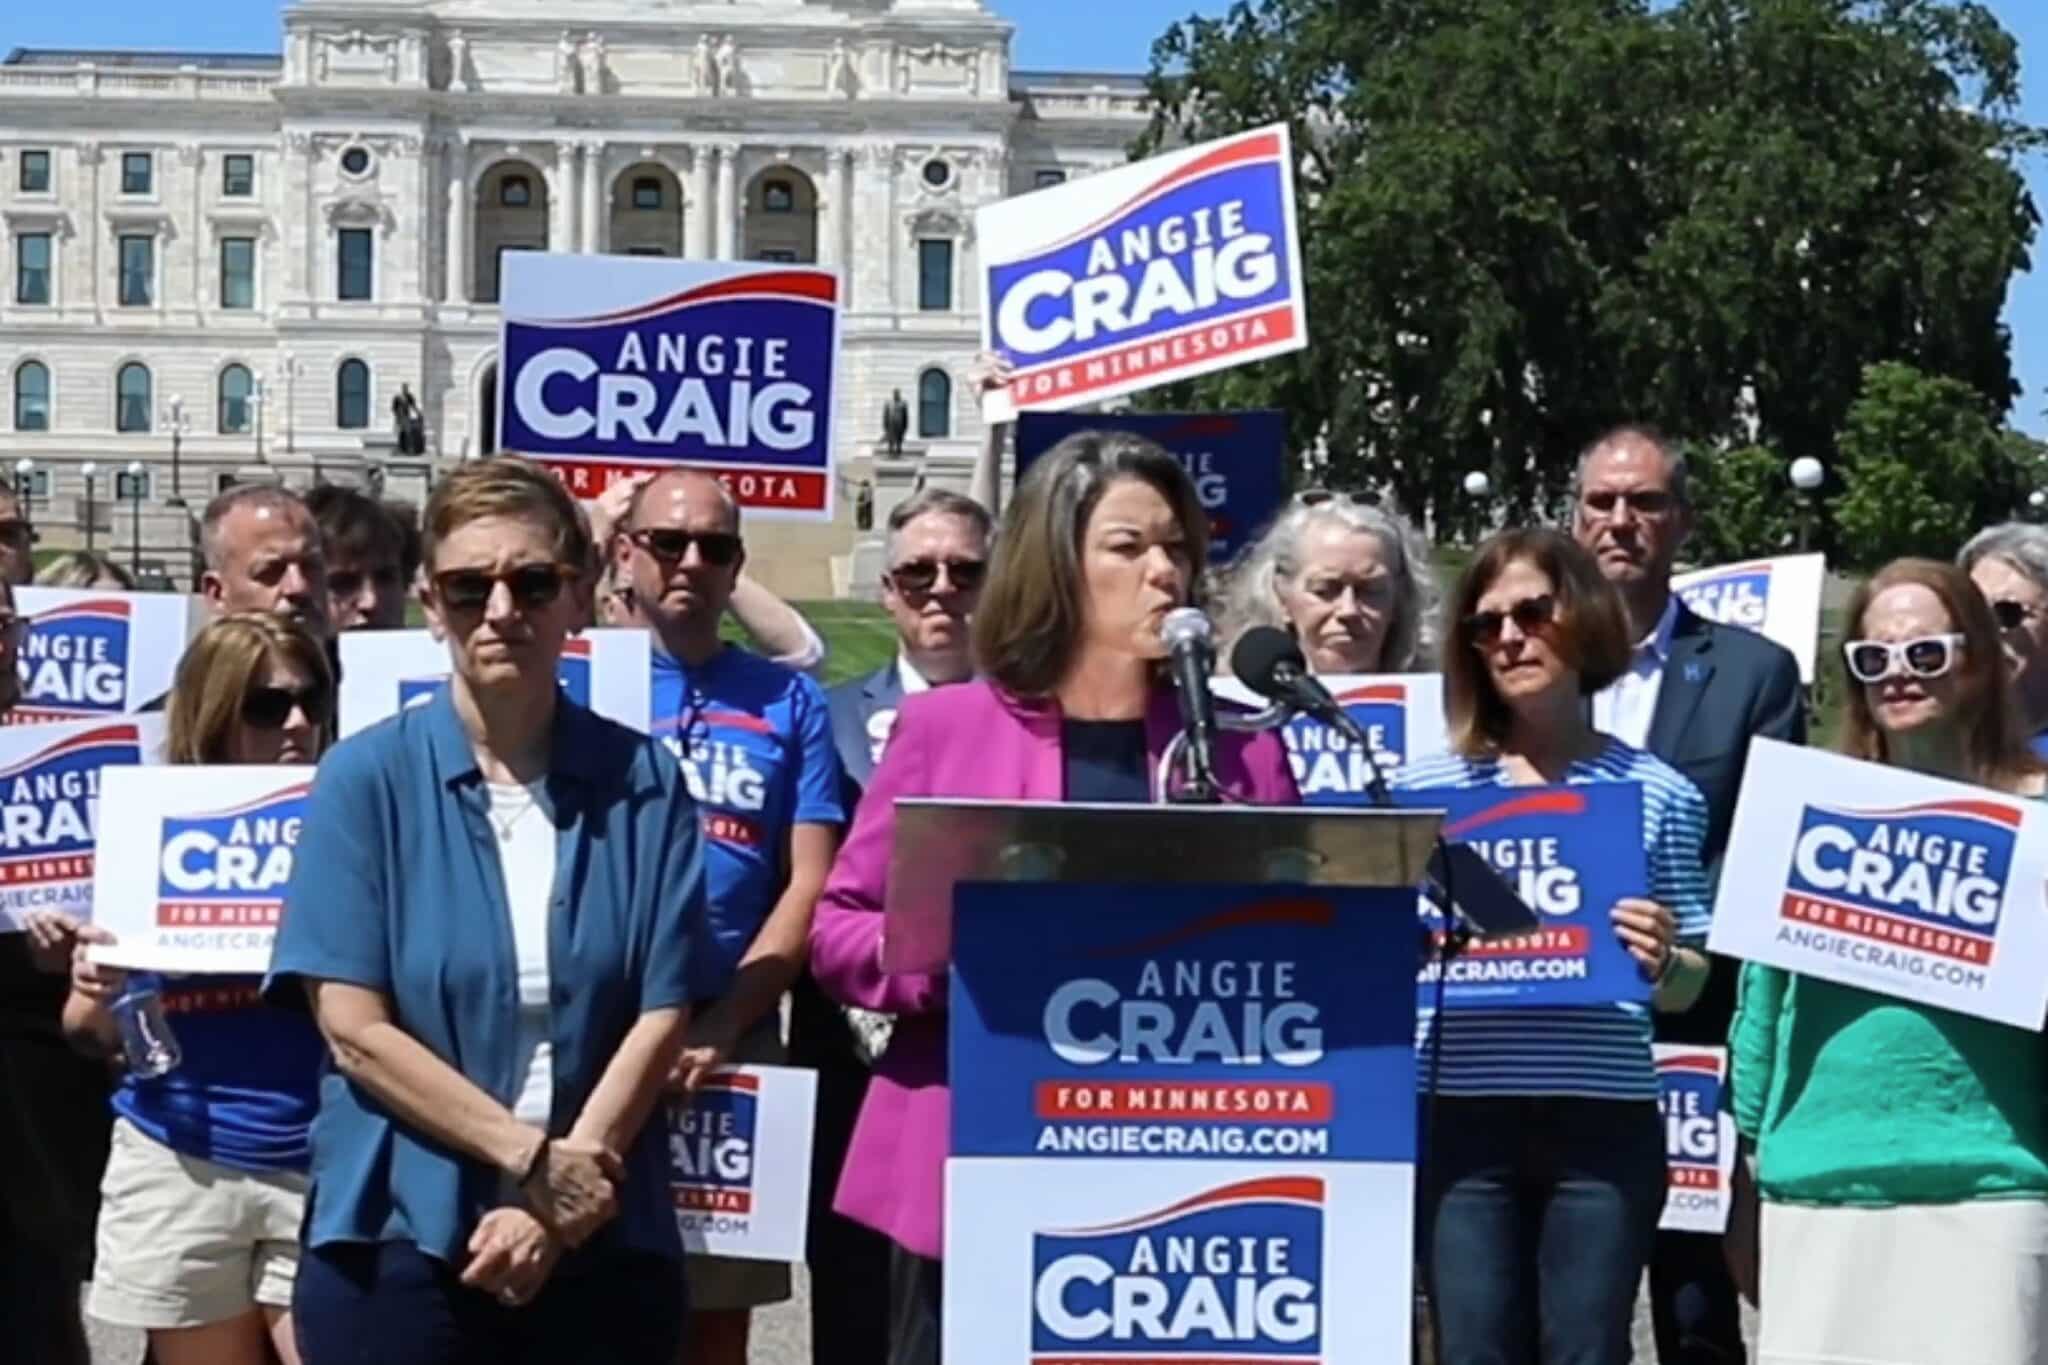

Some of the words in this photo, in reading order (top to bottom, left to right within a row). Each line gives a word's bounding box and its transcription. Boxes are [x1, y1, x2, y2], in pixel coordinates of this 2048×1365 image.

[1086, 201, 1245, 276] ANGIE
[998, 234, 1278, 355] CRAIG
[616, 331, 788, 378] ANGIE
[1018, 374, 1074, 399] FOR
[1086, 319, 1269, 379] MINNESOTA
[513, 348, 816, 450] CRAIG
[17, 633, 108, 661] NGIE
[1795, 824, 2000, 925] CRAIG
[1866, 823, 1989, 876] ANGIE
[169, 906, 212, 922] FOR
[1793, 900, 1841, 923] FOR
[1845, 909, 1979, 959] MINNESOTA
[1137, 961, 1295, 997] ANGIE
[1775, 924, 1986, 990] ANGIECRAIG.COM
[1043, 978, 1324, 1066] CRAIG
[1057, 1088, 1113, 1110] FOR
[1127, 1088, 1310, 1112] MINNESOTA
[1036, 1126, 1328, 1154] ANGIECRAIG.COM
[1129, 1236, 1290, 1275] ANGIE
[1036, 1253, 1317, 1343] CRAIG
